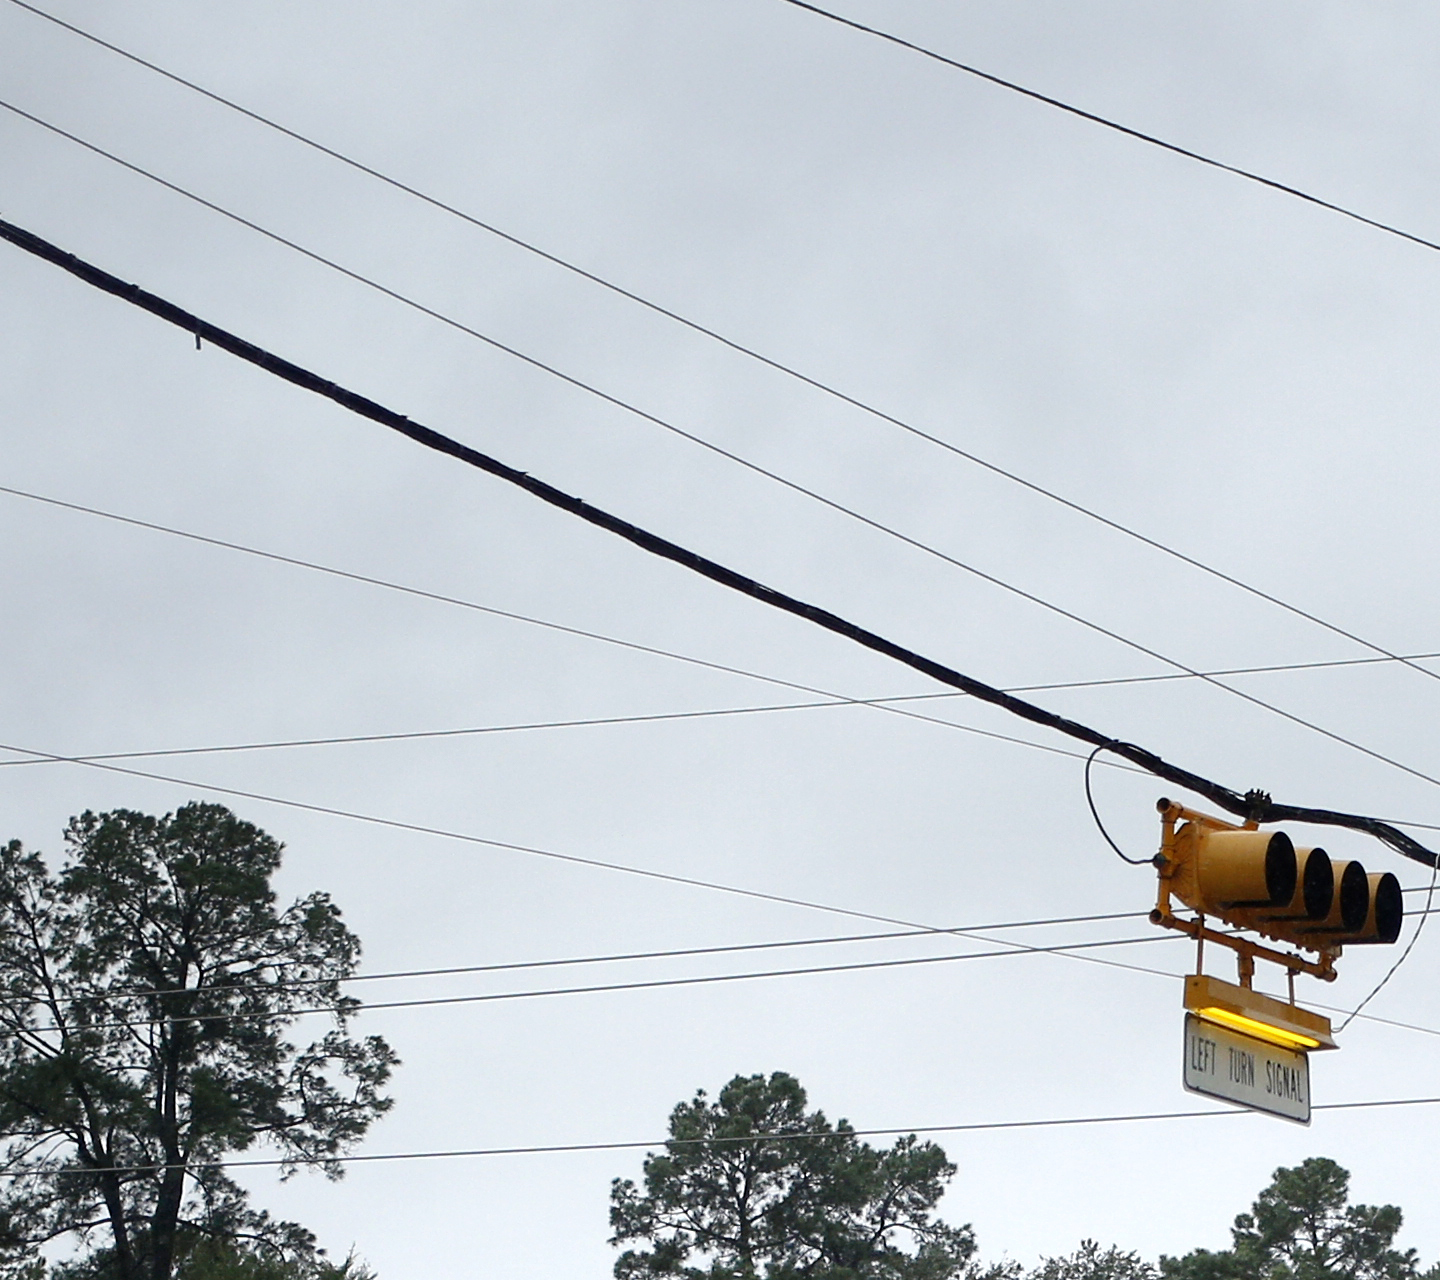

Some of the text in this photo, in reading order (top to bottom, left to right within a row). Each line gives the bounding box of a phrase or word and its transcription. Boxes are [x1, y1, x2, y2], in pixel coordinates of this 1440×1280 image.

[1191, 1036, 1303, 1103] LEFT TURN SIGNAL
